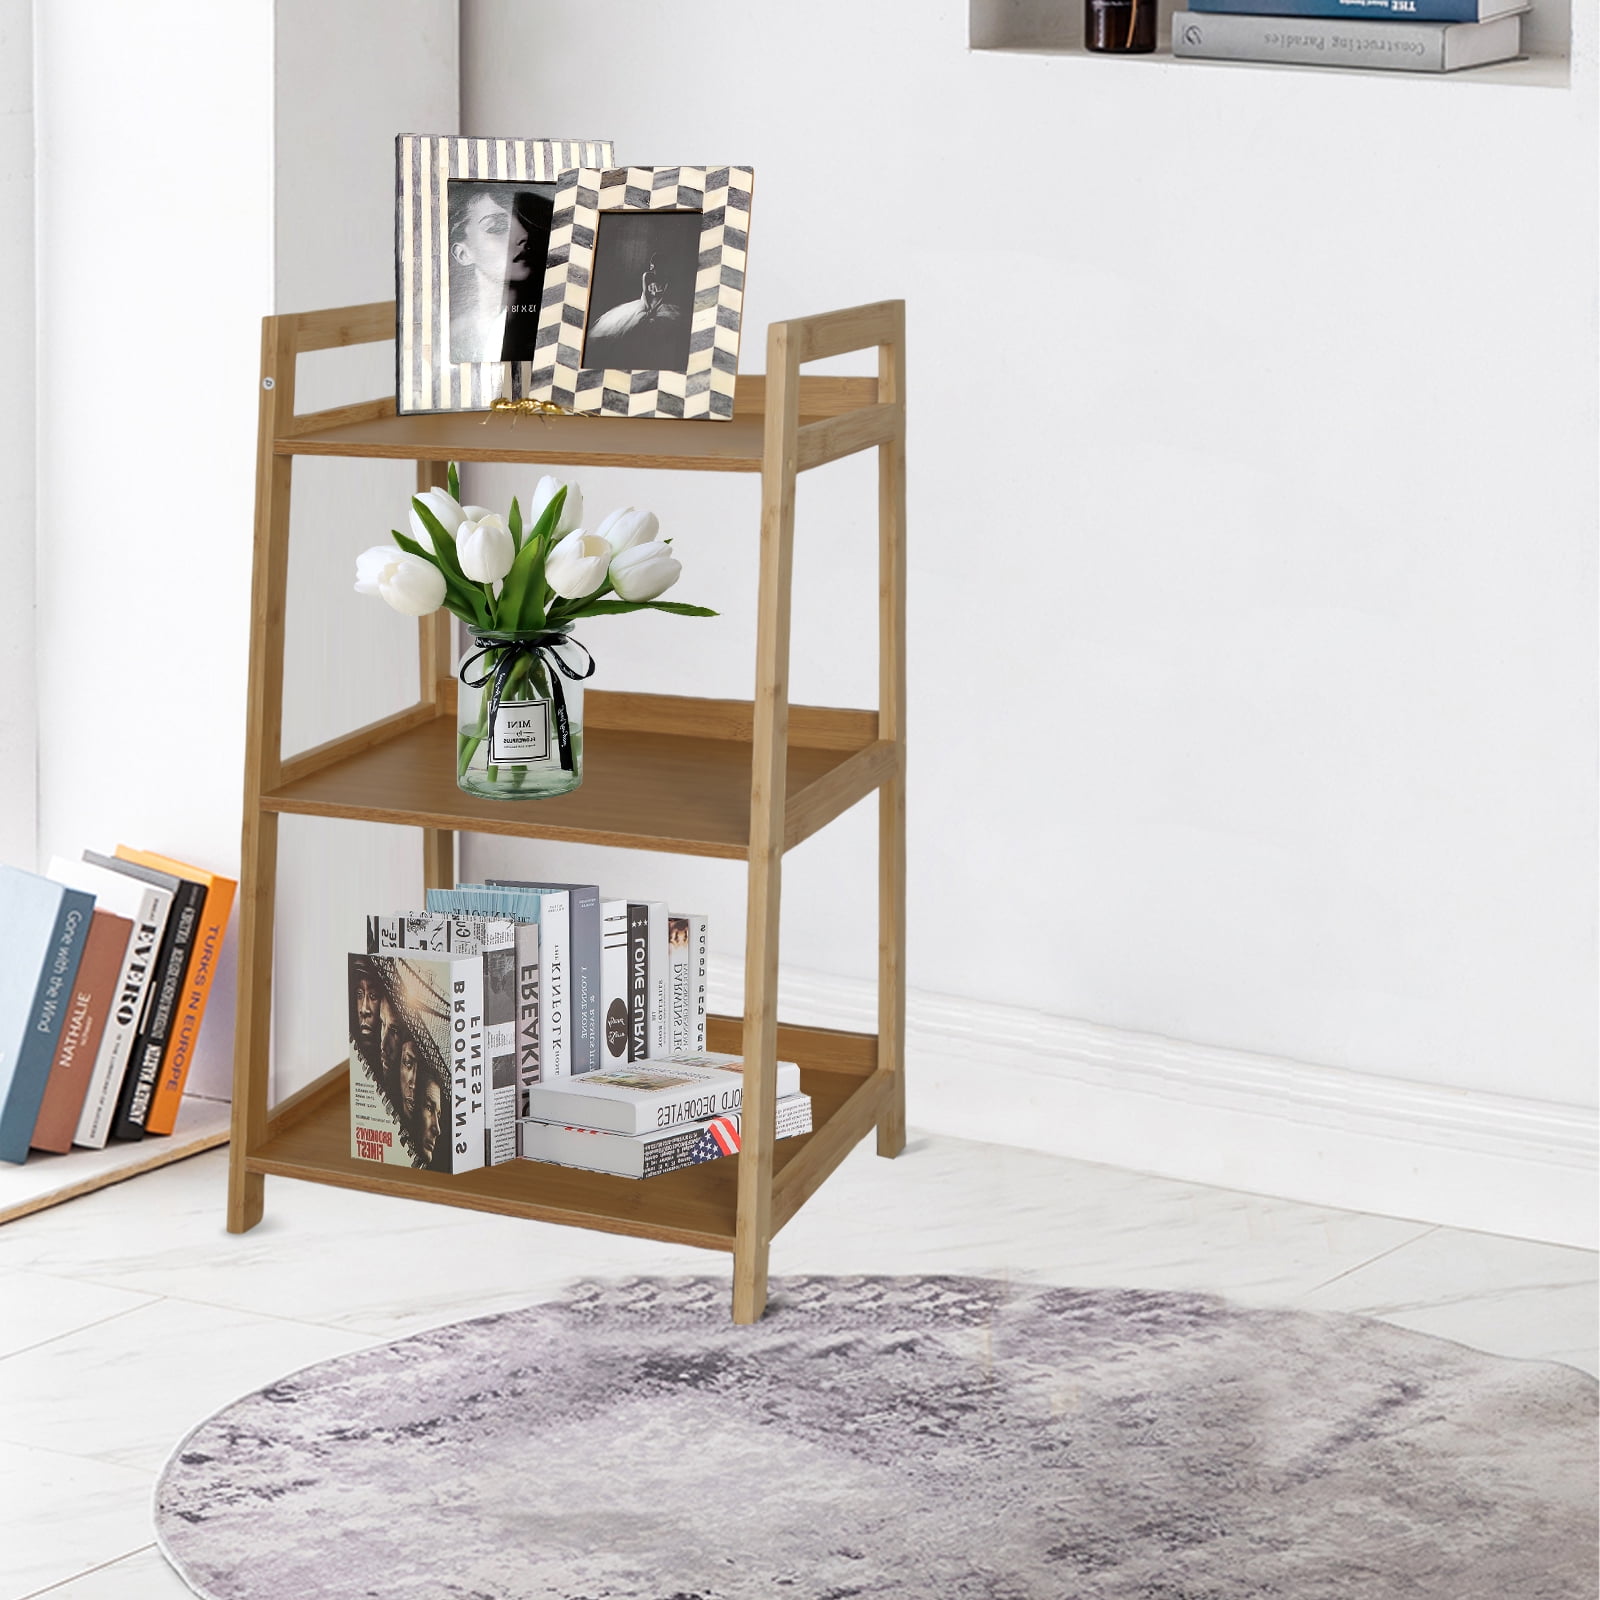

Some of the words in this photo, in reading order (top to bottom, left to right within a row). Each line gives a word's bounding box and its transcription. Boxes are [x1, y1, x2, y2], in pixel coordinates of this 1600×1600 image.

[1263, 33, 1326, 50] Paradies
[1331, 37, 1426, 57] Constructing
[62, 910, 83, 948] Gone
[53, 947, 72, 975] with
[193, 924, 221, 986] TURKS
[47, 974, 65, 999] the
[188, 990, 202, 1010] IN
[36, 995, 58, 1034] Wind
[58, 992, 92, 1068] NATHALIE
[164, 1013, 196, 1092] EUROPE
